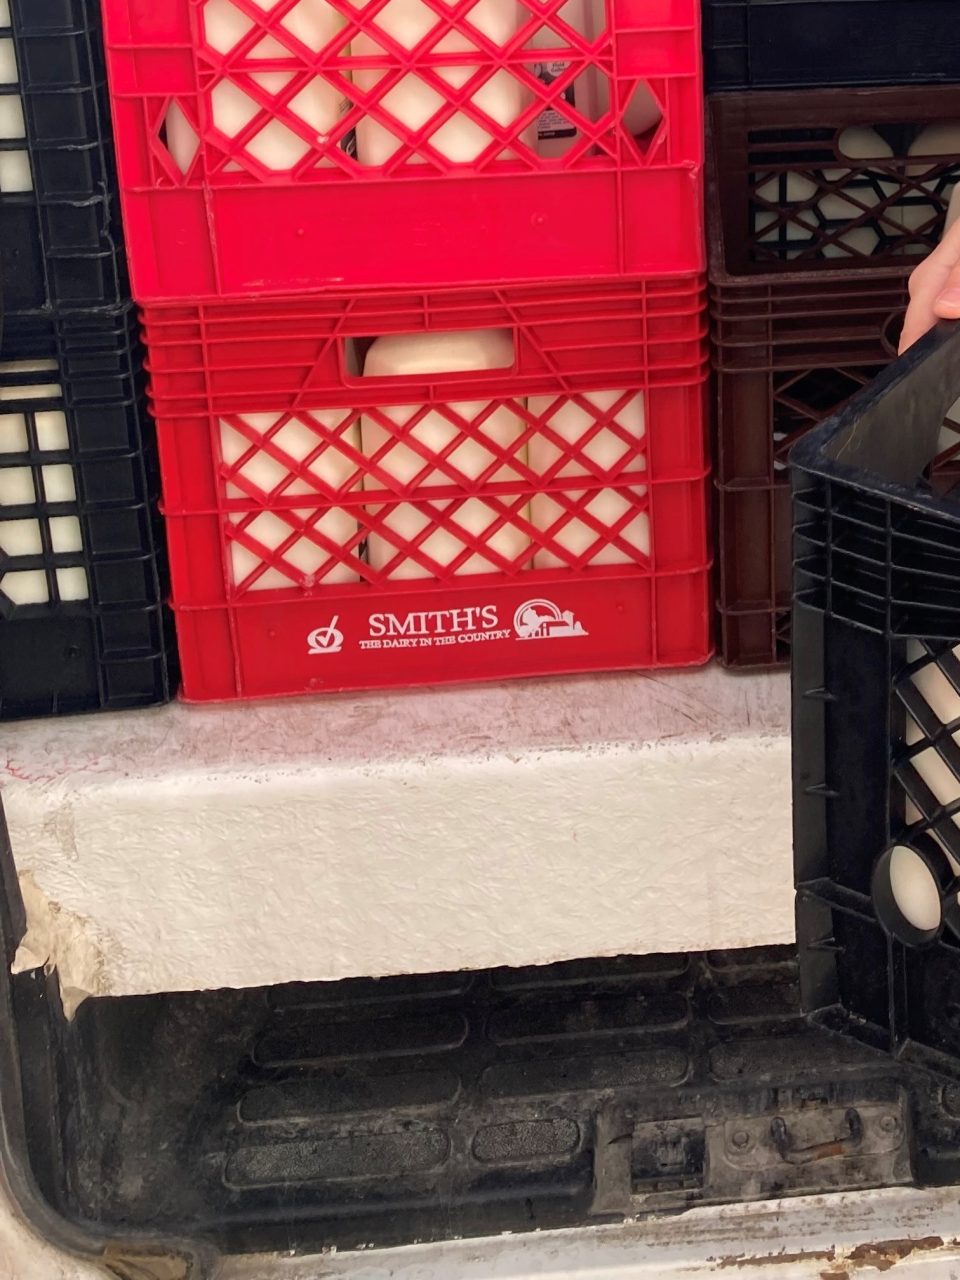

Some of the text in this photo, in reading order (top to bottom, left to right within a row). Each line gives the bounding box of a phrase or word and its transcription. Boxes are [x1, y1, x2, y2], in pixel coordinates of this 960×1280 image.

[368, 604, 500, 638] SMITH'S
[359, 628, 511, 650] THE DAIRY IN THE COUNTRY
